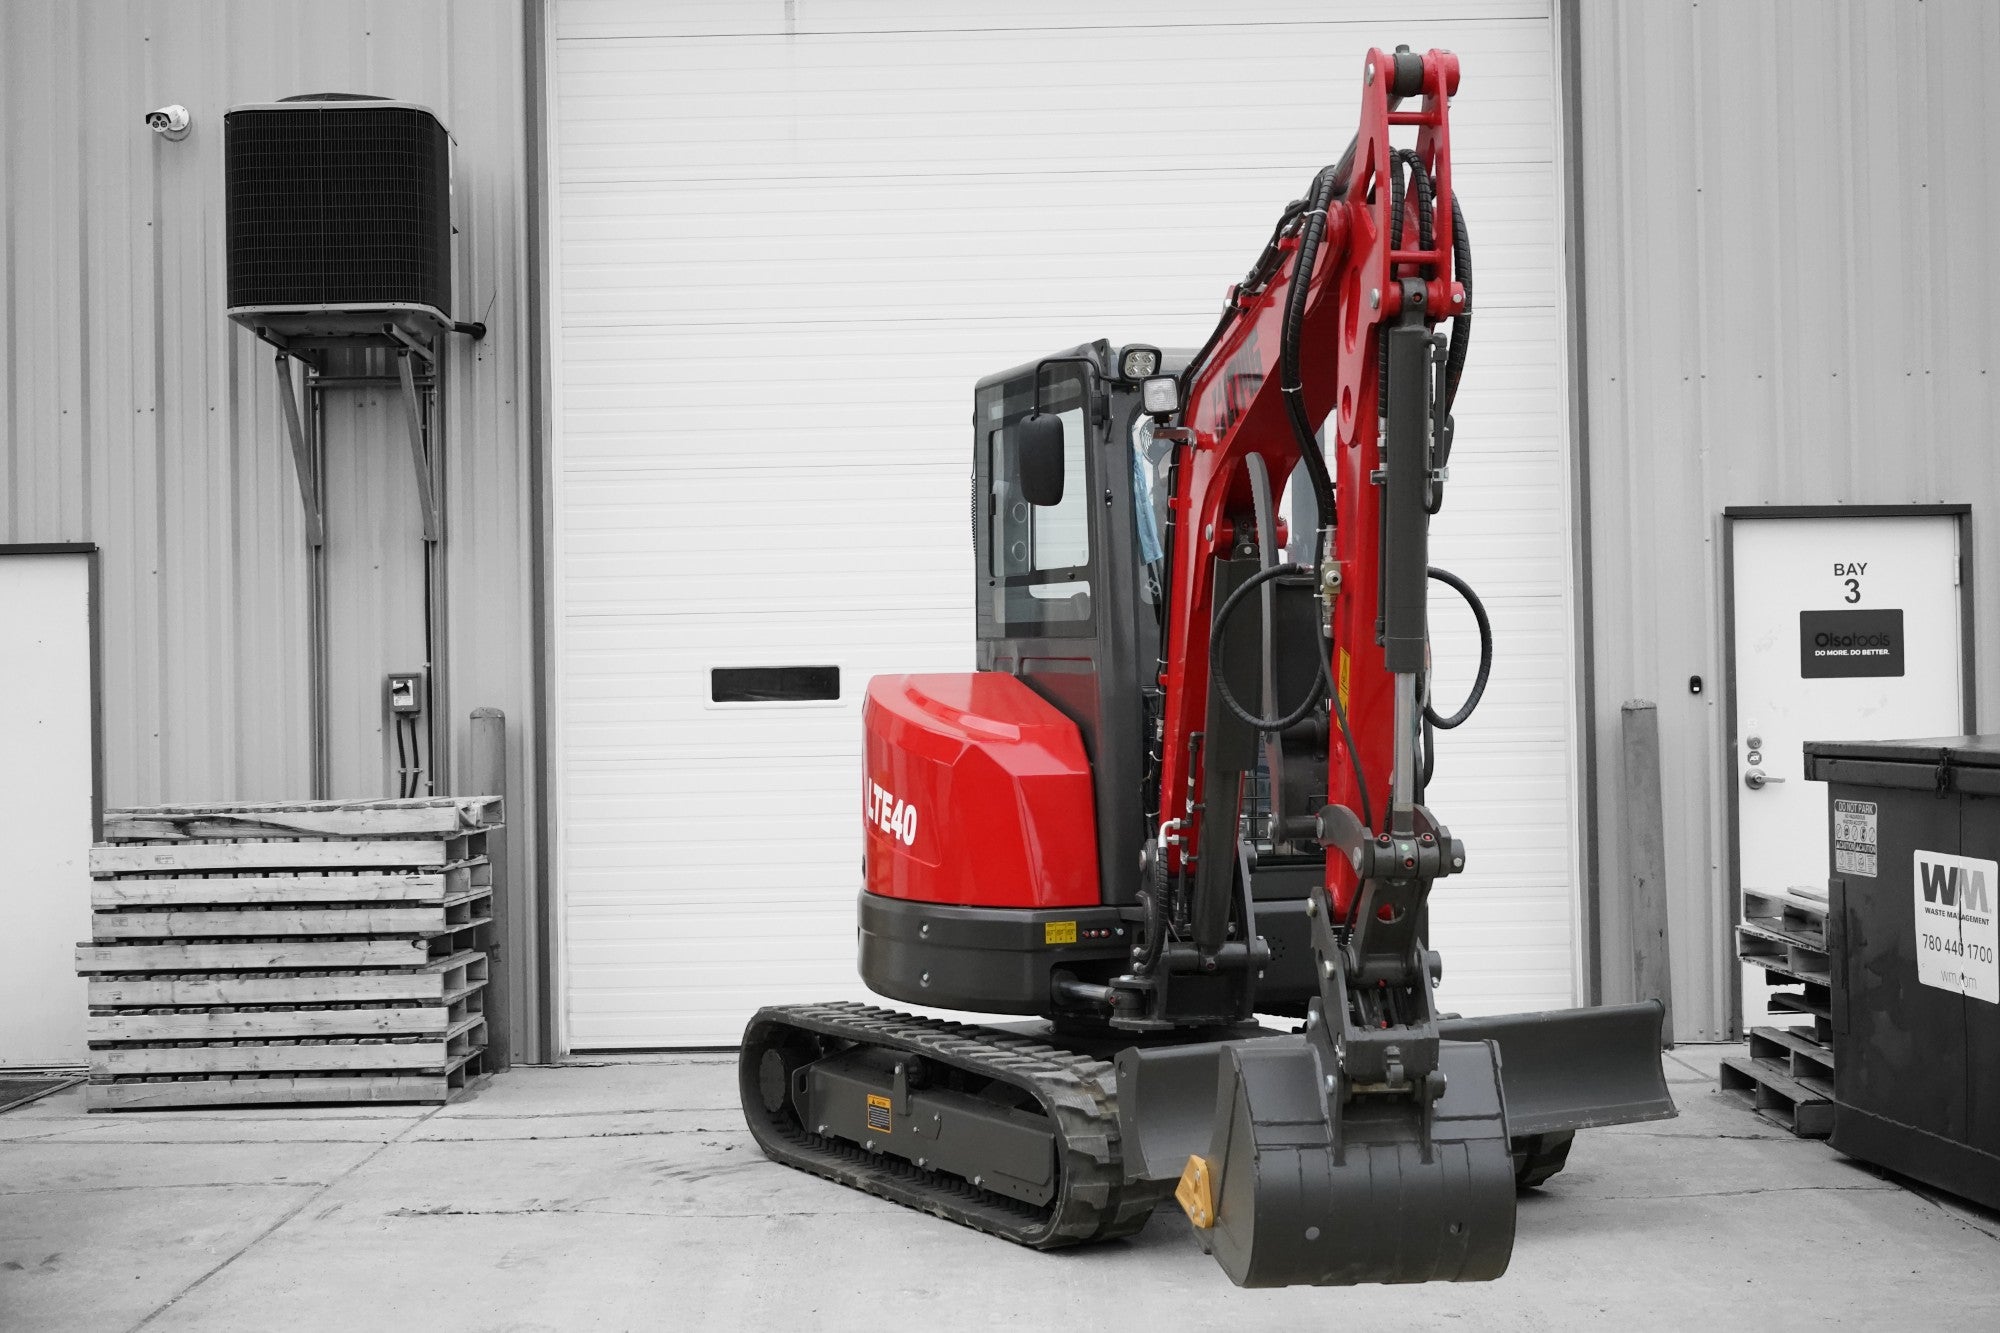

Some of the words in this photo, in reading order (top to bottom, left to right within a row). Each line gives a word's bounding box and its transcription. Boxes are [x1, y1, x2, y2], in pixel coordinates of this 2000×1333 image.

[1834, 562, 1868, 576] BAY
[1844, 578, 1861, 604] 3
[1815, 632, 1890, 647] Olsatools
[868, 777, 917, 846] LTE40
[1838, 801, 1846, 811] DO
[1846, 802, 1857, 813] NOT
[1858, 803, 1874, 814] PARK
[1920, 862, 1989, 913] WM
[1925, 907, 1946, 917] WASTE
[1922, 934, 1942, 952] 780
[1945, 939, 1964, 957] 440
[1967, 944, 1993, 964] 1700
